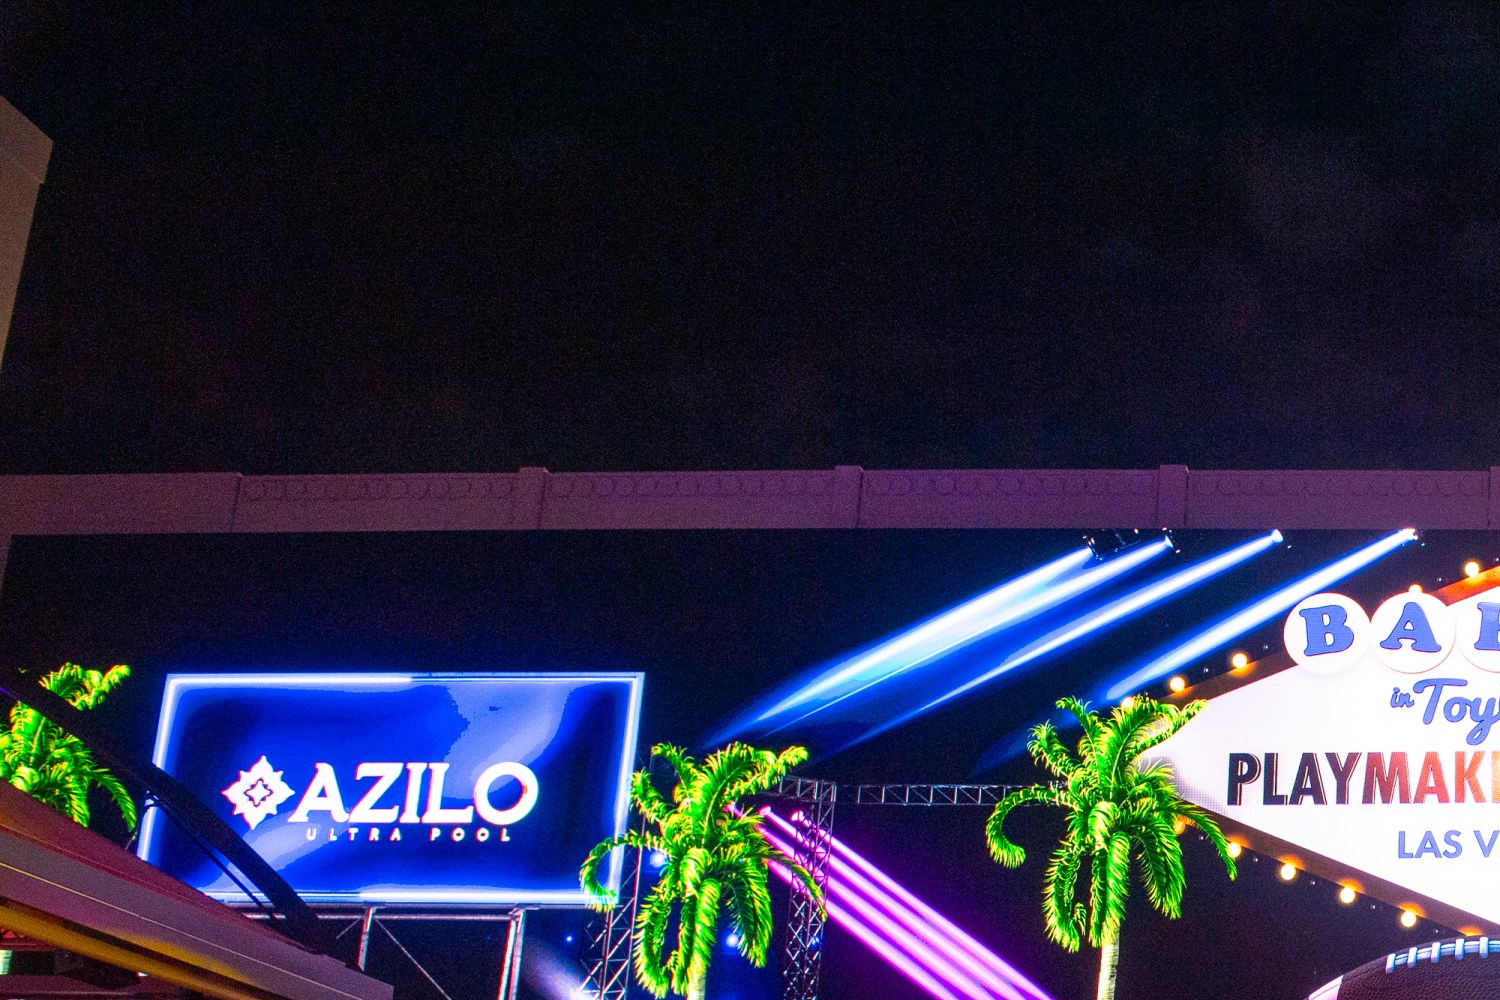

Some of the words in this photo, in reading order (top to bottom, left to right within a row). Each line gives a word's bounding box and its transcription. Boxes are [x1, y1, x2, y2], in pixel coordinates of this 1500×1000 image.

[1389, 686, 1415, 709] in
[287, 761, 539, 826] AZILO
[306, 827, 402, 842] ULTRA
[429, 827, 511, 842] POOL
[1397, 829, 1463, 859] LAS
